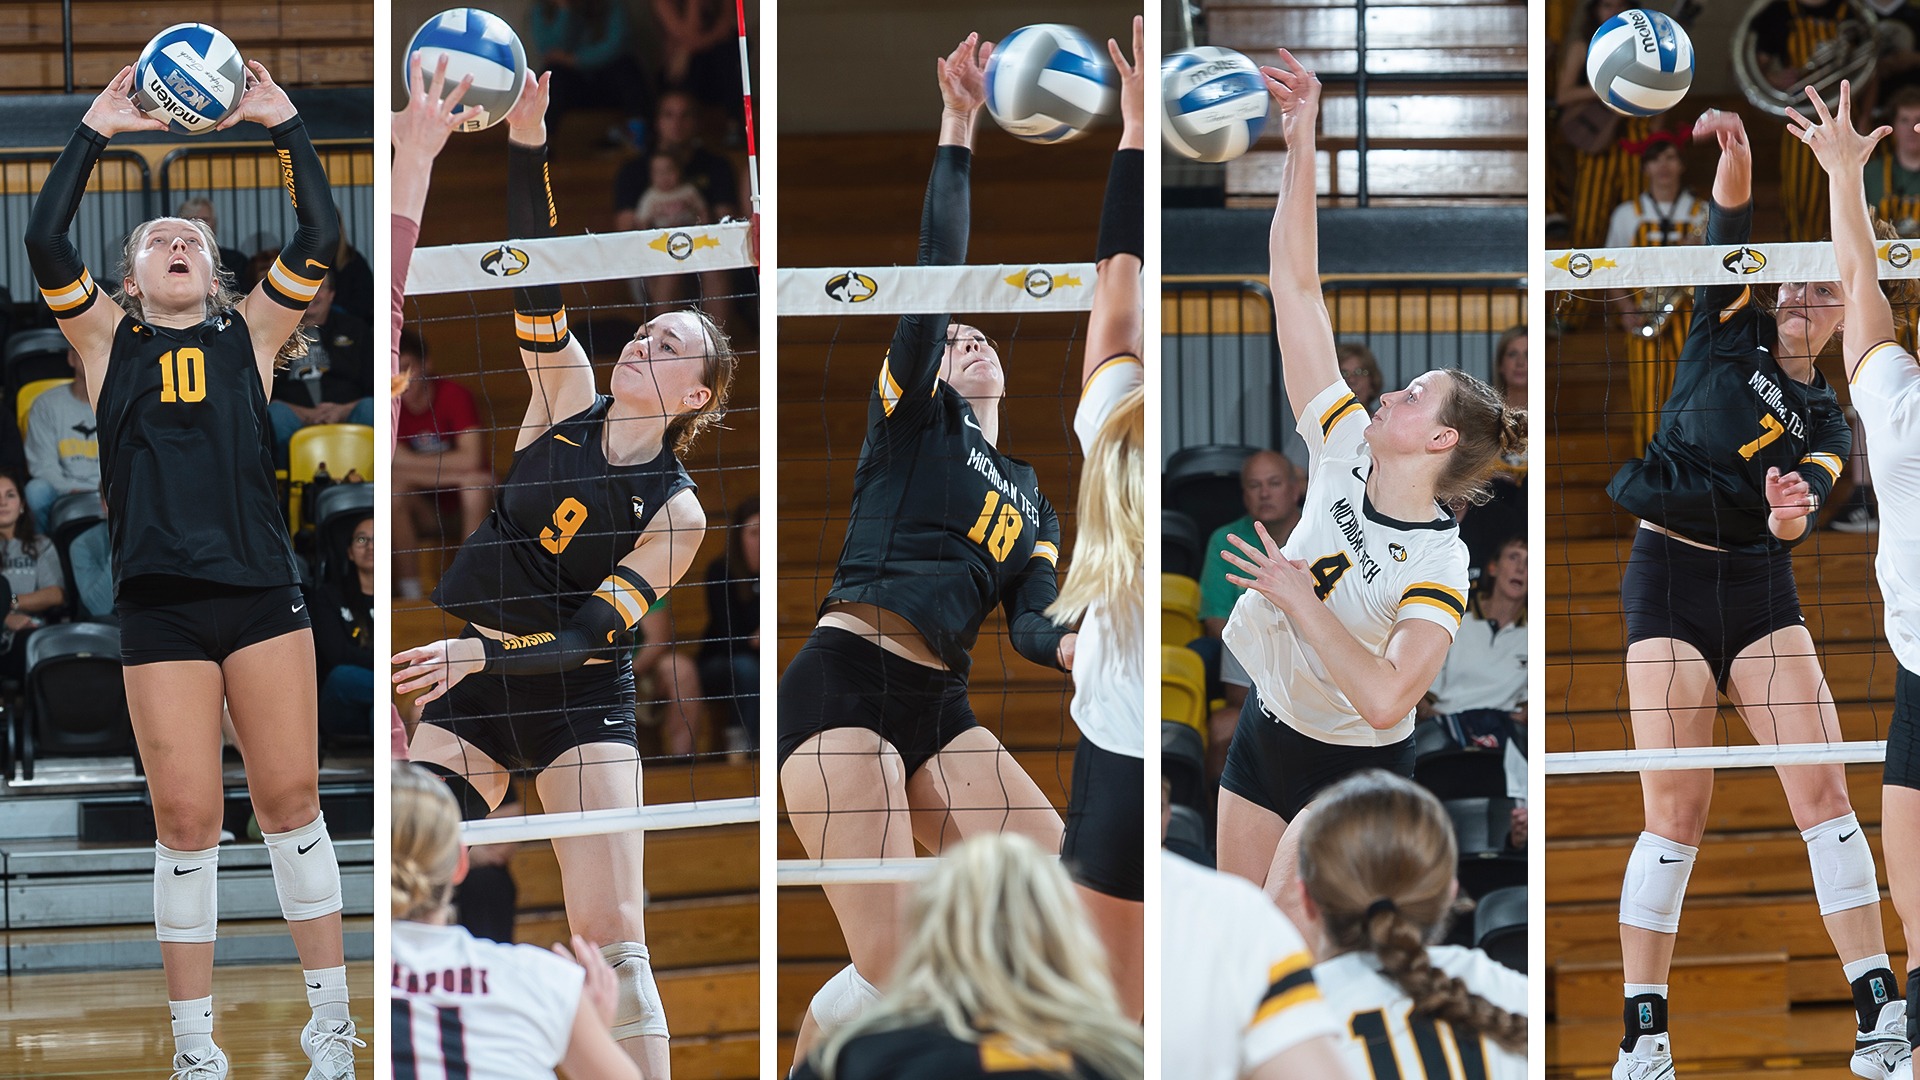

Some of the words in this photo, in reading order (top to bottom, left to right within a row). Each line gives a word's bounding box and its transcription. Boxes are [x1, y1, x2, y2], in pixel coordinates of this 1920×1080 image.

[1628, 11, 1657, 54] molten
[150, 78, 201, 125] molten
[165, 69, 213, 112] NCAA
[159, 347, 207, 403] 10
[1737, 412, 1785, 462] 7
[1786, 411, 1808, 442] TEC
[966, 446, 1018, 504] MICHIGAN
[538, 496, 589, 555] 9
[966, 489, 1024, 563] 18
[1309, 549, 1354, 603] 4
[502, 631, 557, 650] HUSKIES
